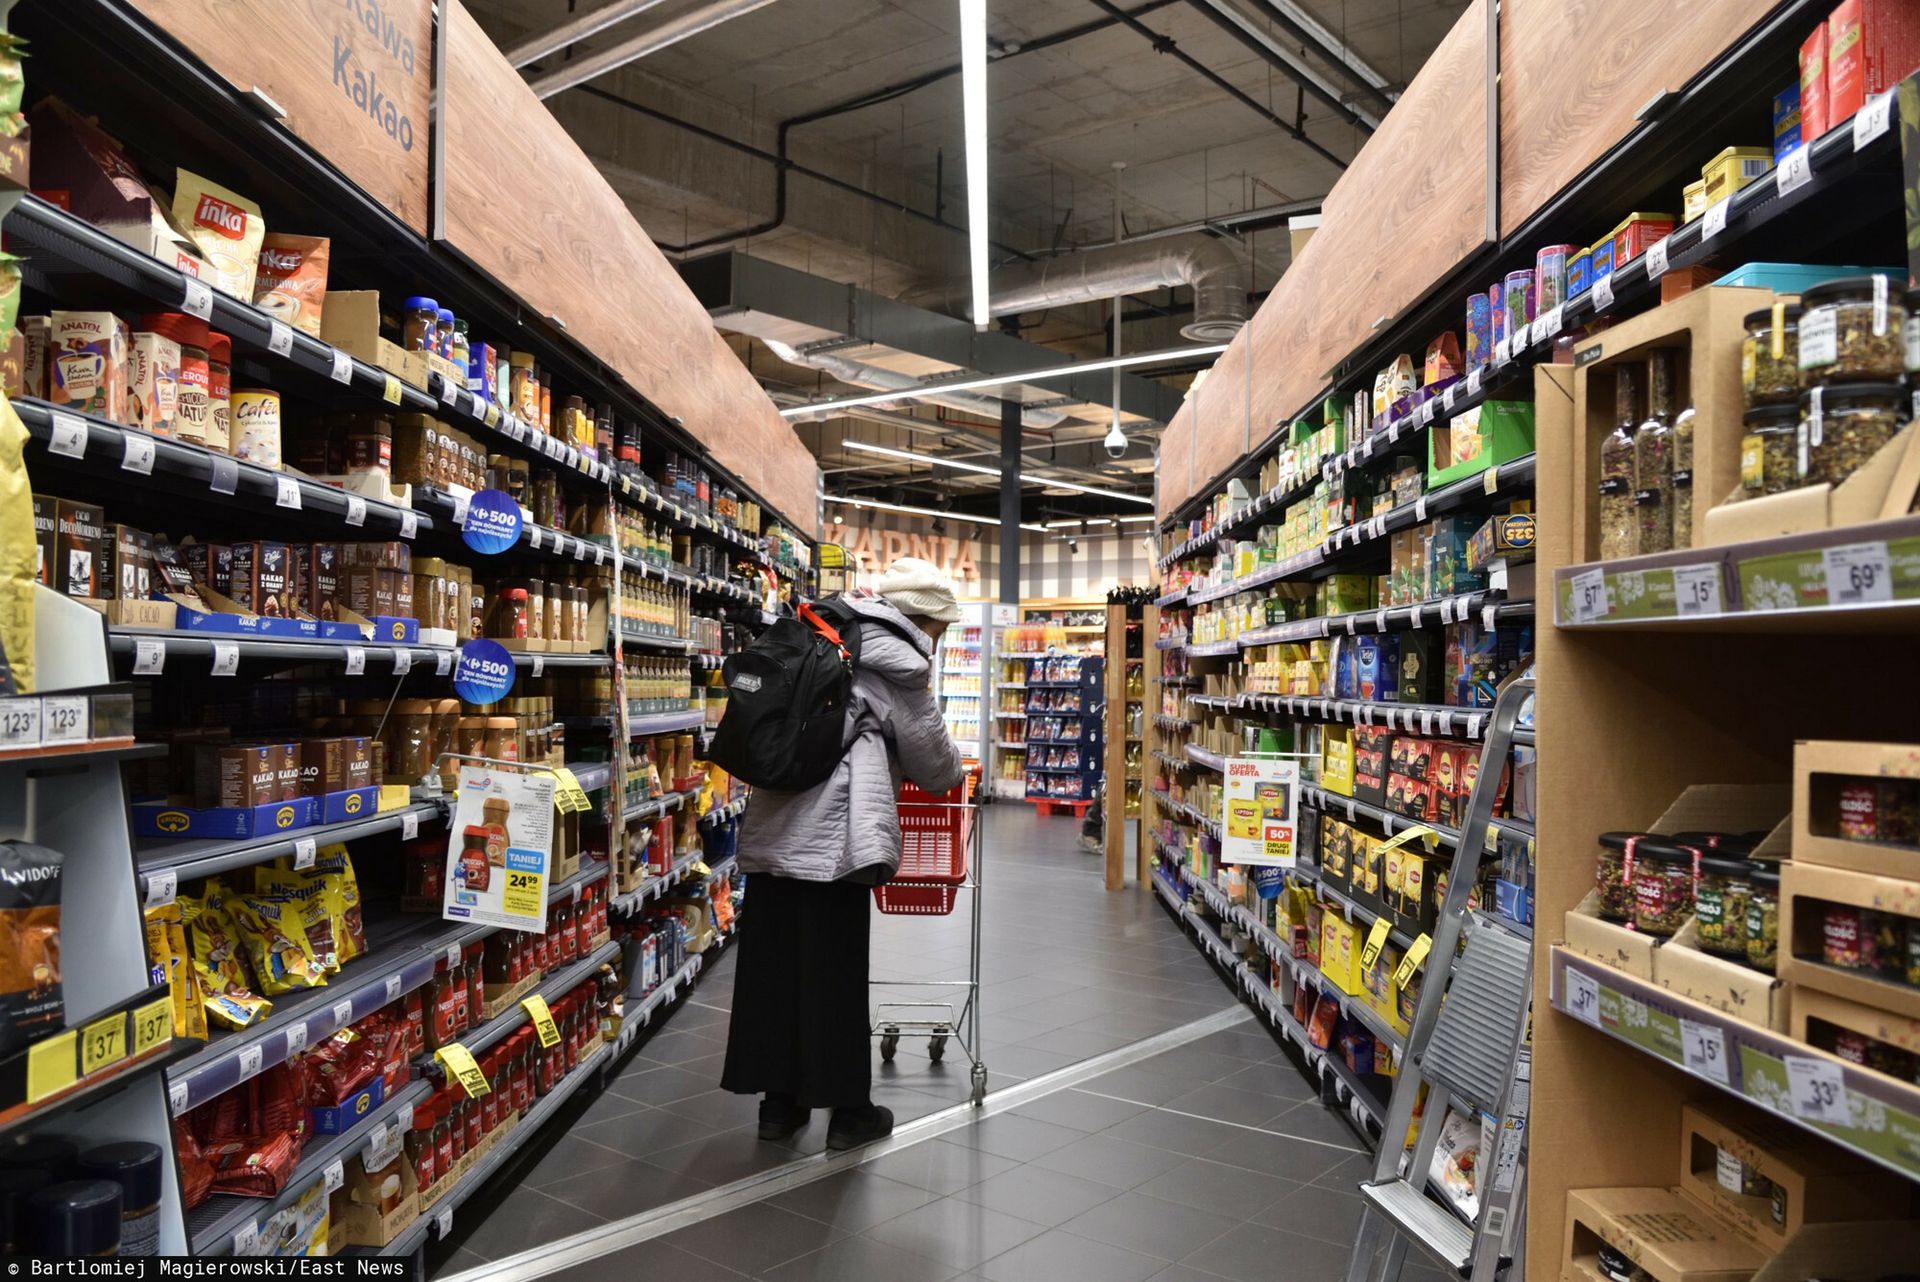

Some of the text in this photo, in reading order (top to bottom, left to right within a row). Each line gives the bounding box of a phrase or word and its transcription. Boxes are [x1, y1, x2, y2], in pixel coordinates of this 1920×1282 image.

[333, 34, 413, 152] Kakao
[200, 199, 242, 232] inka
[178, 257, 198, 278] inka
[260, 249, 300, 270] nka
[60, 321, 102, 334] ANATOL
[135, 350, 147, 386] ANATOL
[75, 510, 90, 522] CACAO
[489, 510, 517, 527] 500
[1506, 527, 1534, 540] 325
[260, 573, 284, 583] KAKAO
[318, 576, 336, 585] KAKAO
[1850, 563, 1875, 590] 69
[396, 593, 412, 603] KAKAO
[1584, 585, 1597, 606] 67
[1691, 581, 1709, 602] 15
[139, 606, 160, 624] CACAO
[238, 618, 257, 627] KAKAO
[300, 622, 317, 631] KAKAO
[481, 659, 508, 676] 500
[4, 712, 31, 734] 123
[51, 708, 77, 729] 123
[278, 768, 299, 780] KAKAO
[350, 760, 370, 771] KAKAO
[1229, 763, 1256, 772] SUPER
[1229, 769, 1260, 777] OFERTA
[253, 772, 275, 785] KAKAO
[509, 853, 542, 865] TANIEJ
[270, 879, 327, 901] Nesquik
[509, 874, 538, 888] 24 99
[1577, 986, 1591, 1009] 37
[146, 1014, 163, 1042] 37
[96, 1030, 116, 1059] 37
[1699, 1037, 1717, 1061] 15
[1810, 1079, 1834, 1106] 33
[390, 1206, 414, 1230] MOKATE
